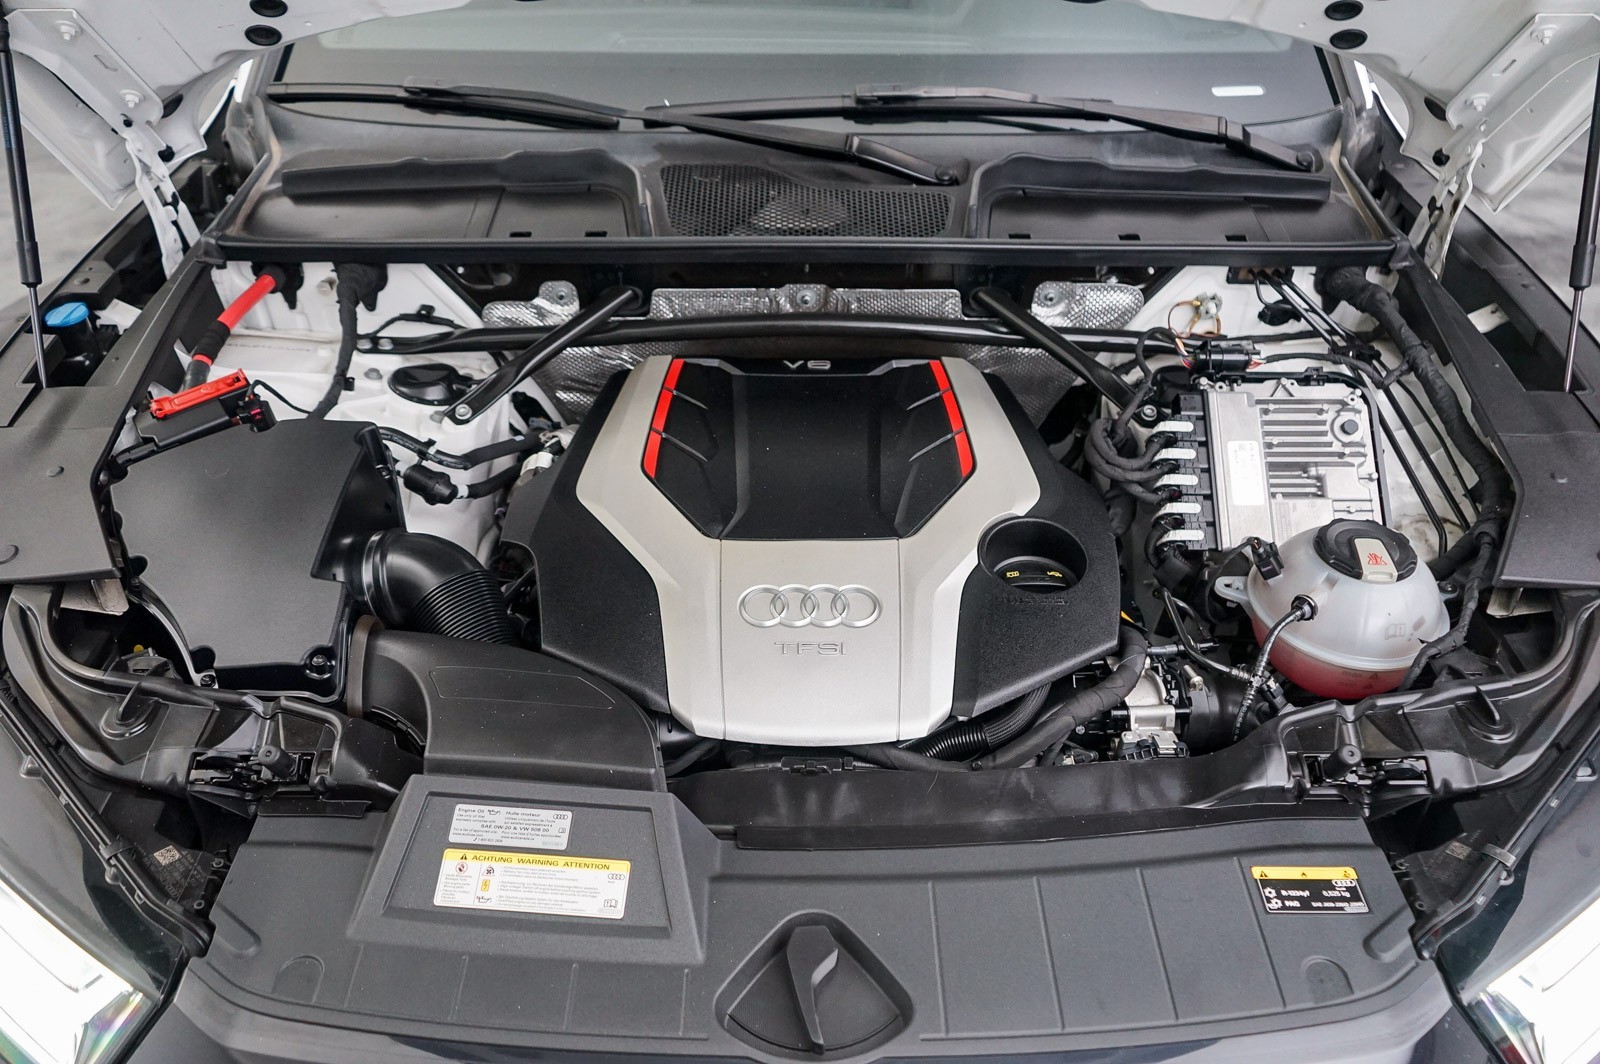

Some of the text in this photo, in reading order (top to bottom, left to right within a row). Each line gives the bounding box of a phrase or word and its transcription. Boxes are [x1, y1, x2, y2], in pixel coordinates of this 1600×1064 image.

[783, 360, 831, 370] V6
[774, 642, 846, 656] TFSI
[472, 855, 610, 870] ACHTUNG WARNING ATTENTION
